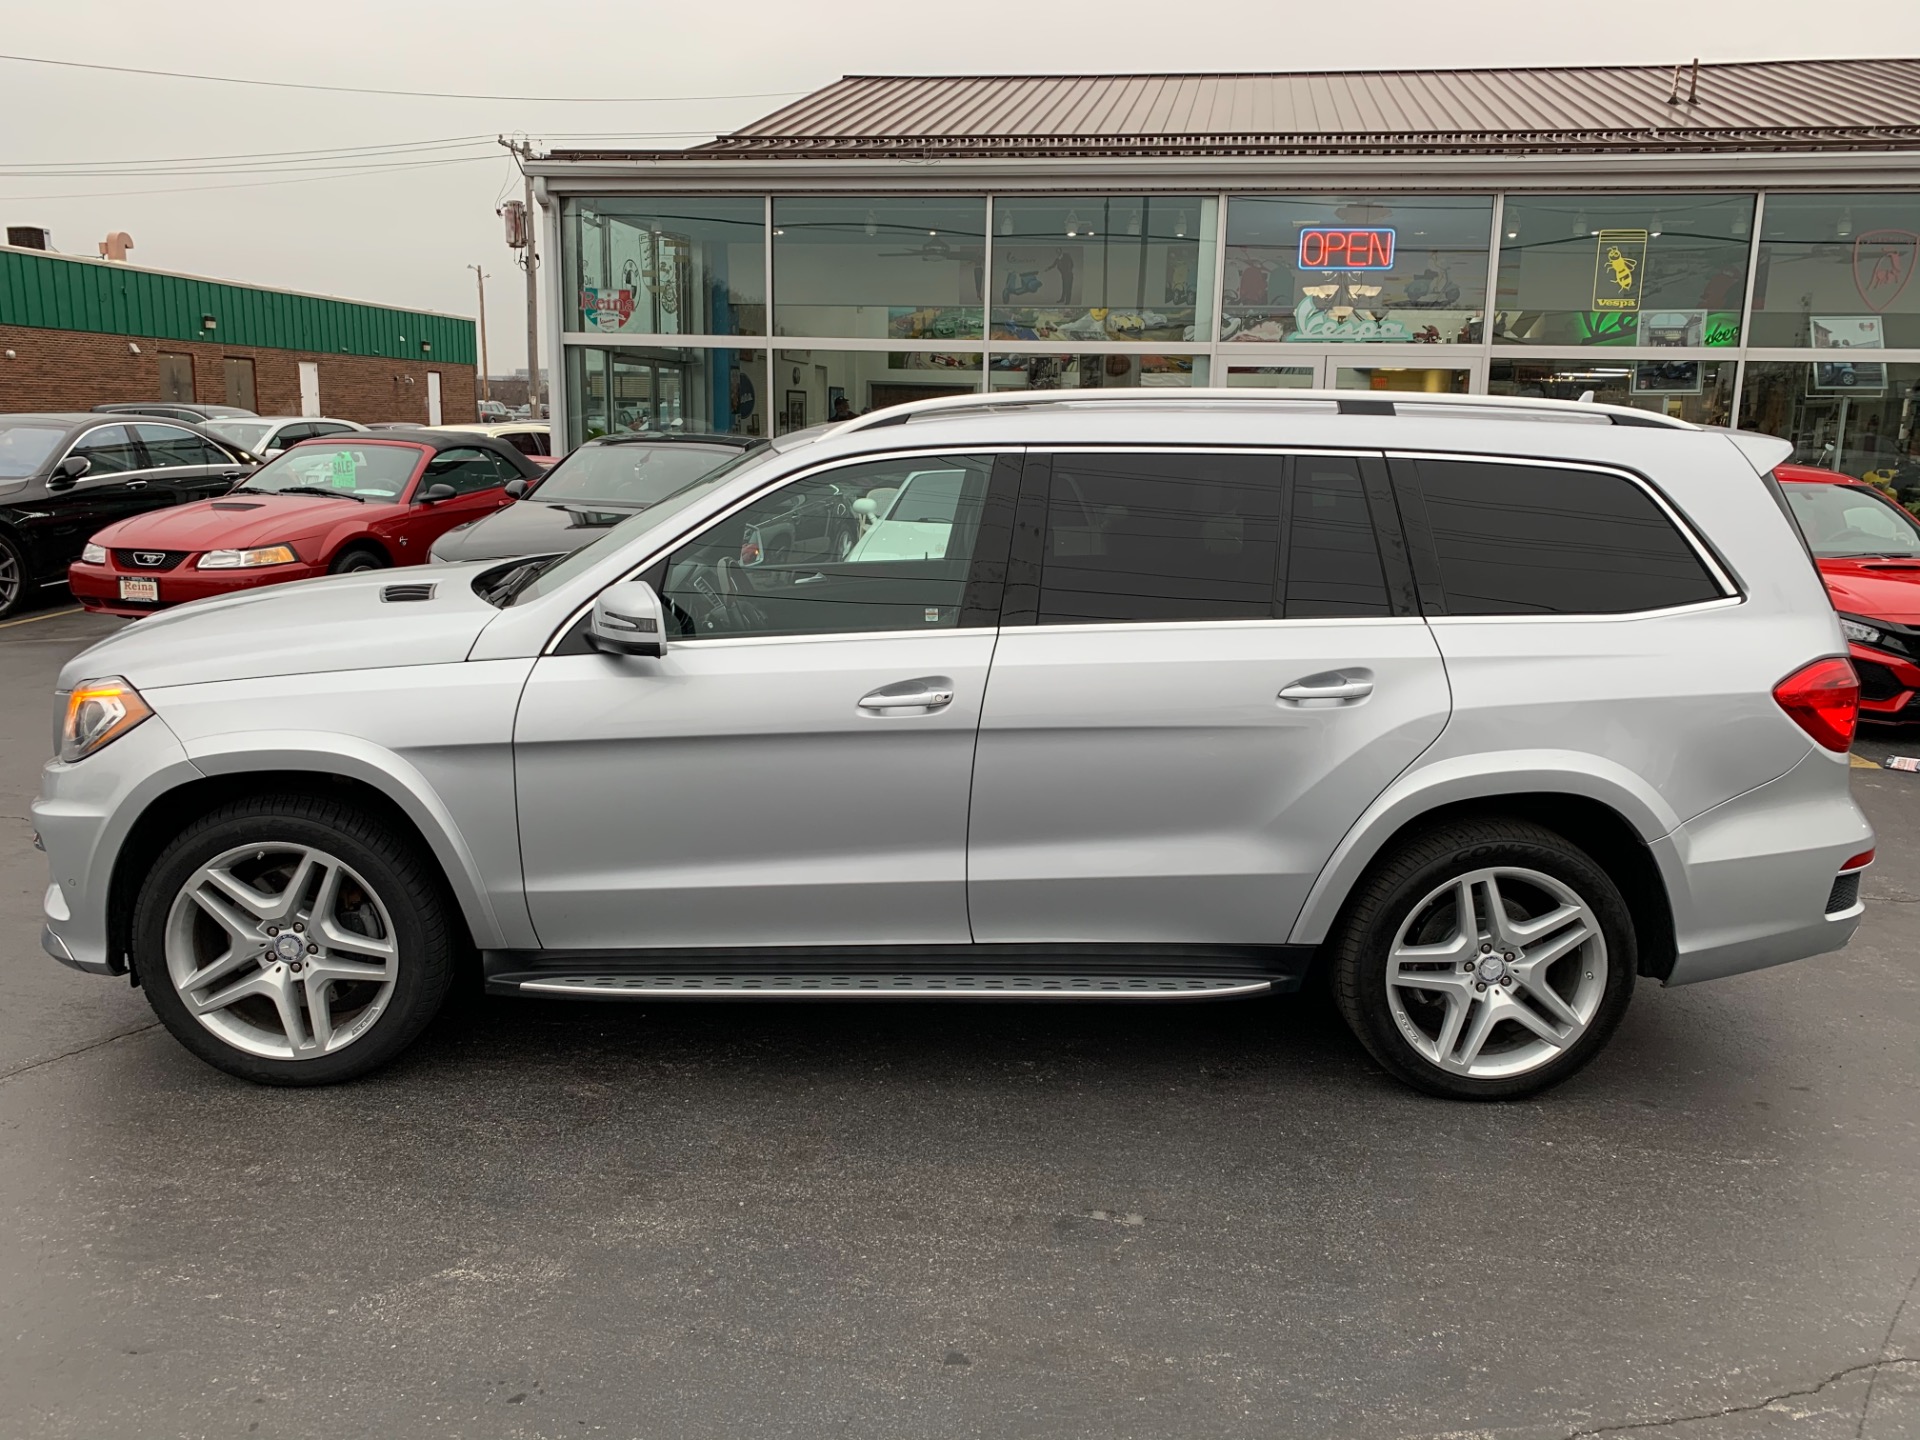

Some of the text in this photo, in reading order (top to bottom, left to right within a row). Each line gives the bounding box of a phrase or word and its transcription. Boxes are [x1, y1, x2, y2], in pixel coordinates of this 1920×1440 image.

[1303, 231, 1392, 267] OPEN
[579, 291, 636, 312] Reina
[1596, 298, 1636, 308] Vespa
[1289, 295, 1411, 341] Vespa
[124, 581, 154, 591] Reina
